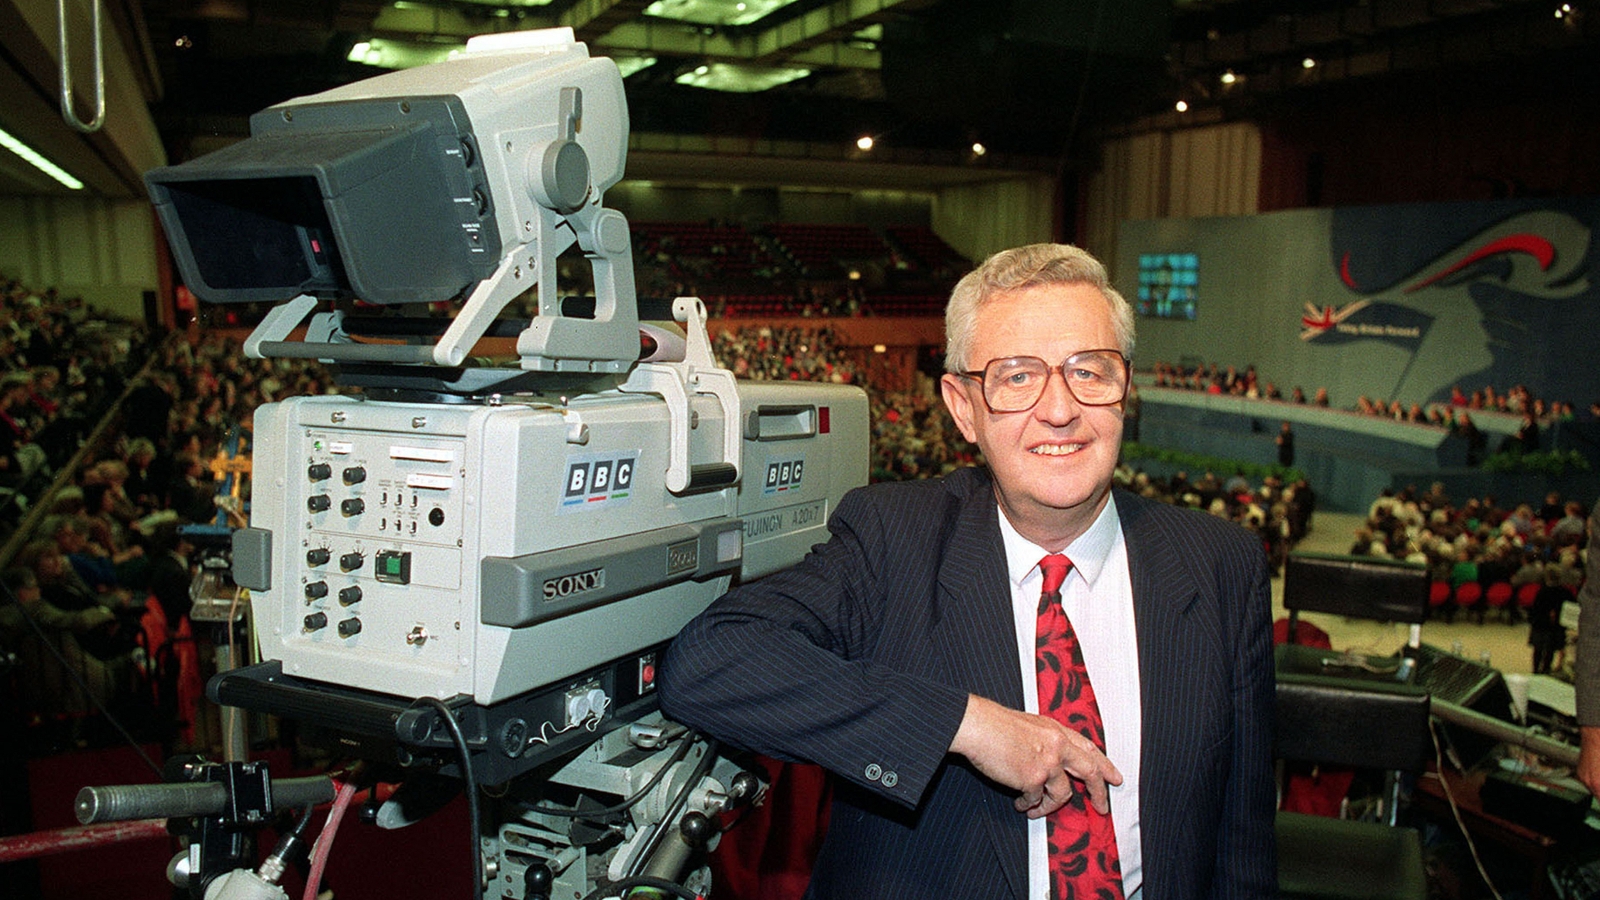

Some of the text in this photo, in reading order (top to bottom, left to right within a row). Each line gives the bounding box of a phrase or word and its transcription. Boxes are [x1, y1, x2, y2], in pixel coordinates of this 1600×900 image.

[567, 461, 632, 494] BBC
[767, 463, 803, 485] BBC
[741, 514, 783, 538] FUJINON
[542, 568, 605, 601] SONY
